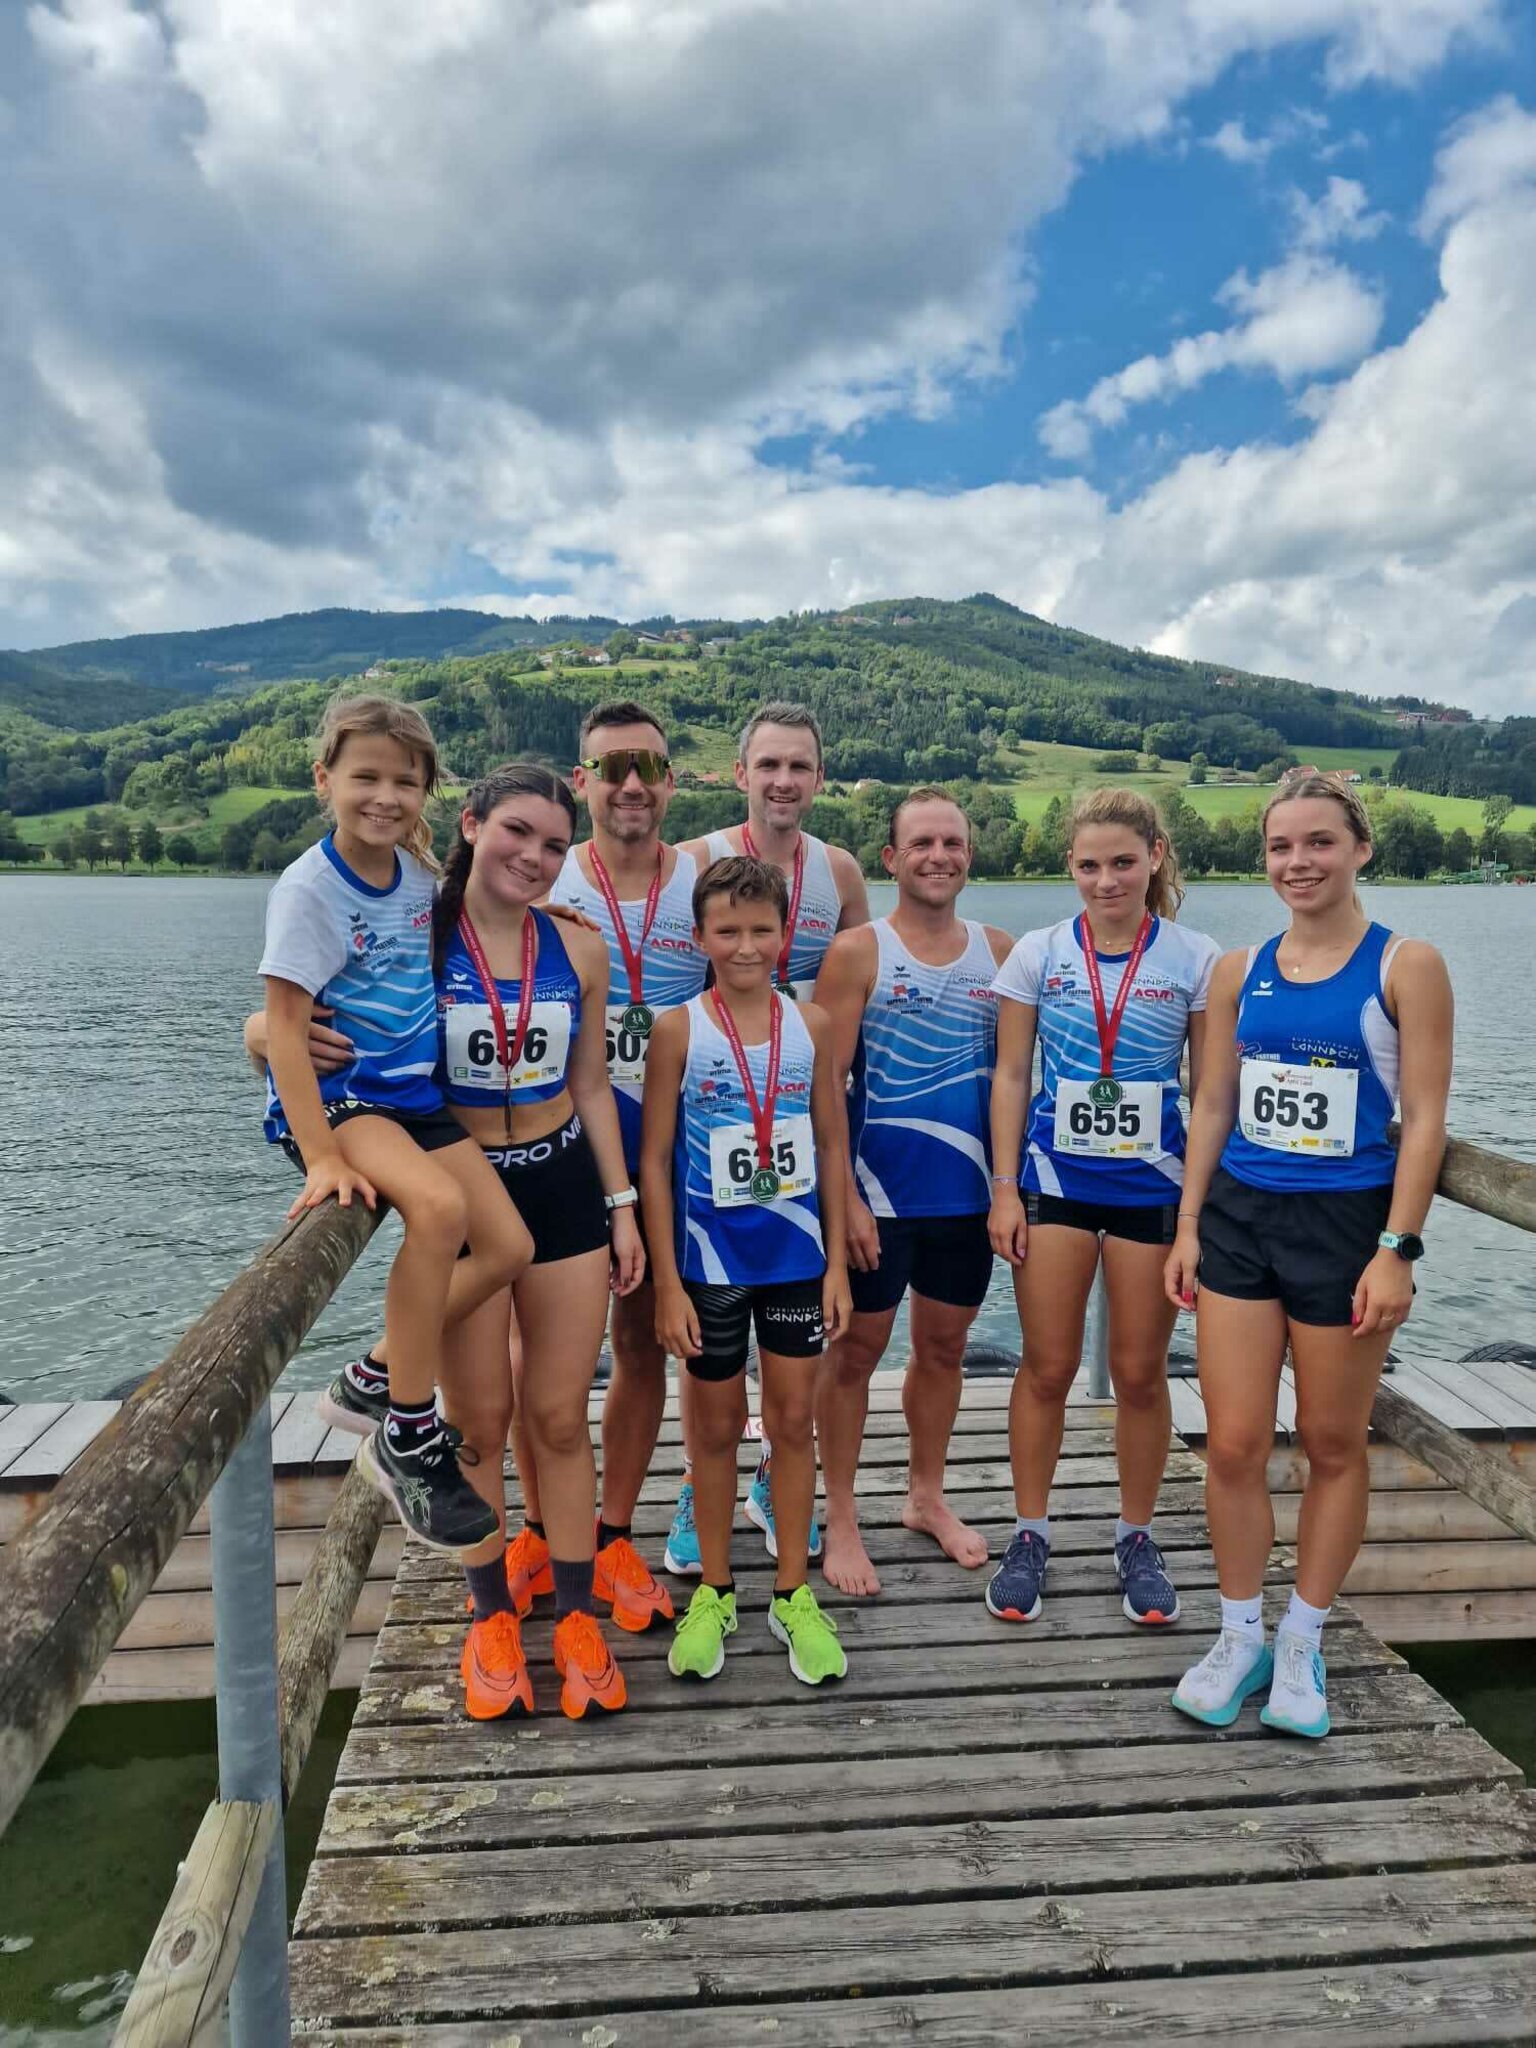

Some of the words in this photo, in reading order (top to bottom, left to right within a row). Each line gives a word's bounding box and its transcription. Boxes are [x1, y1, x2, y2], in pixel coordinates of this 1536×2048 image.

[1070, 1102, 1140, 1137] 655
[1254, 1086, 1328, 1131] 653
[484, 1143, 551, 1168] PRO
[766, 1312, 820, 1322] LANNAC
